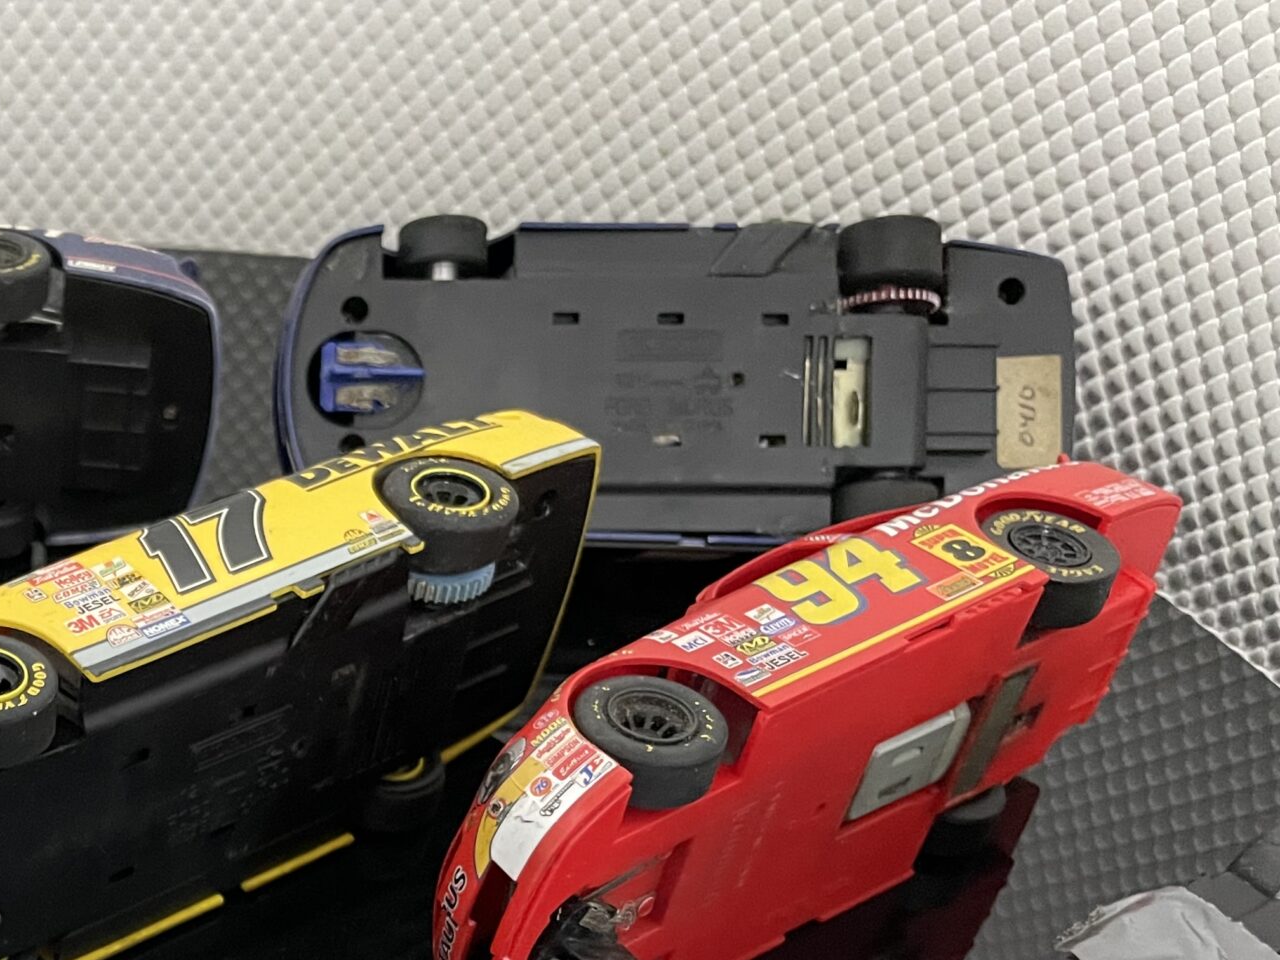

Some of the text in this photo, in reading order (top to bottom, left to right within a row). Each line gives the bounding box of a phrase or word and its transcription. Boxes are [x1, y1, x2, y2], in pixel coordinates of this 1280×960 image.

[137, 487, 273, 596] 17
[941, 538, 987, 563] 8
[752, 537, 922, 626] 94
[63, 587, 113, 610] Bowman
[77, 594, 122, 616] JESEL
[67, 614, 101, 635] 3M
[143, 614, 189, 637] NOMEX
[680, 636, 710, 652] MCI
[765, 650, 808, 671] JESEL
[533, 780, 550, 794] 76
